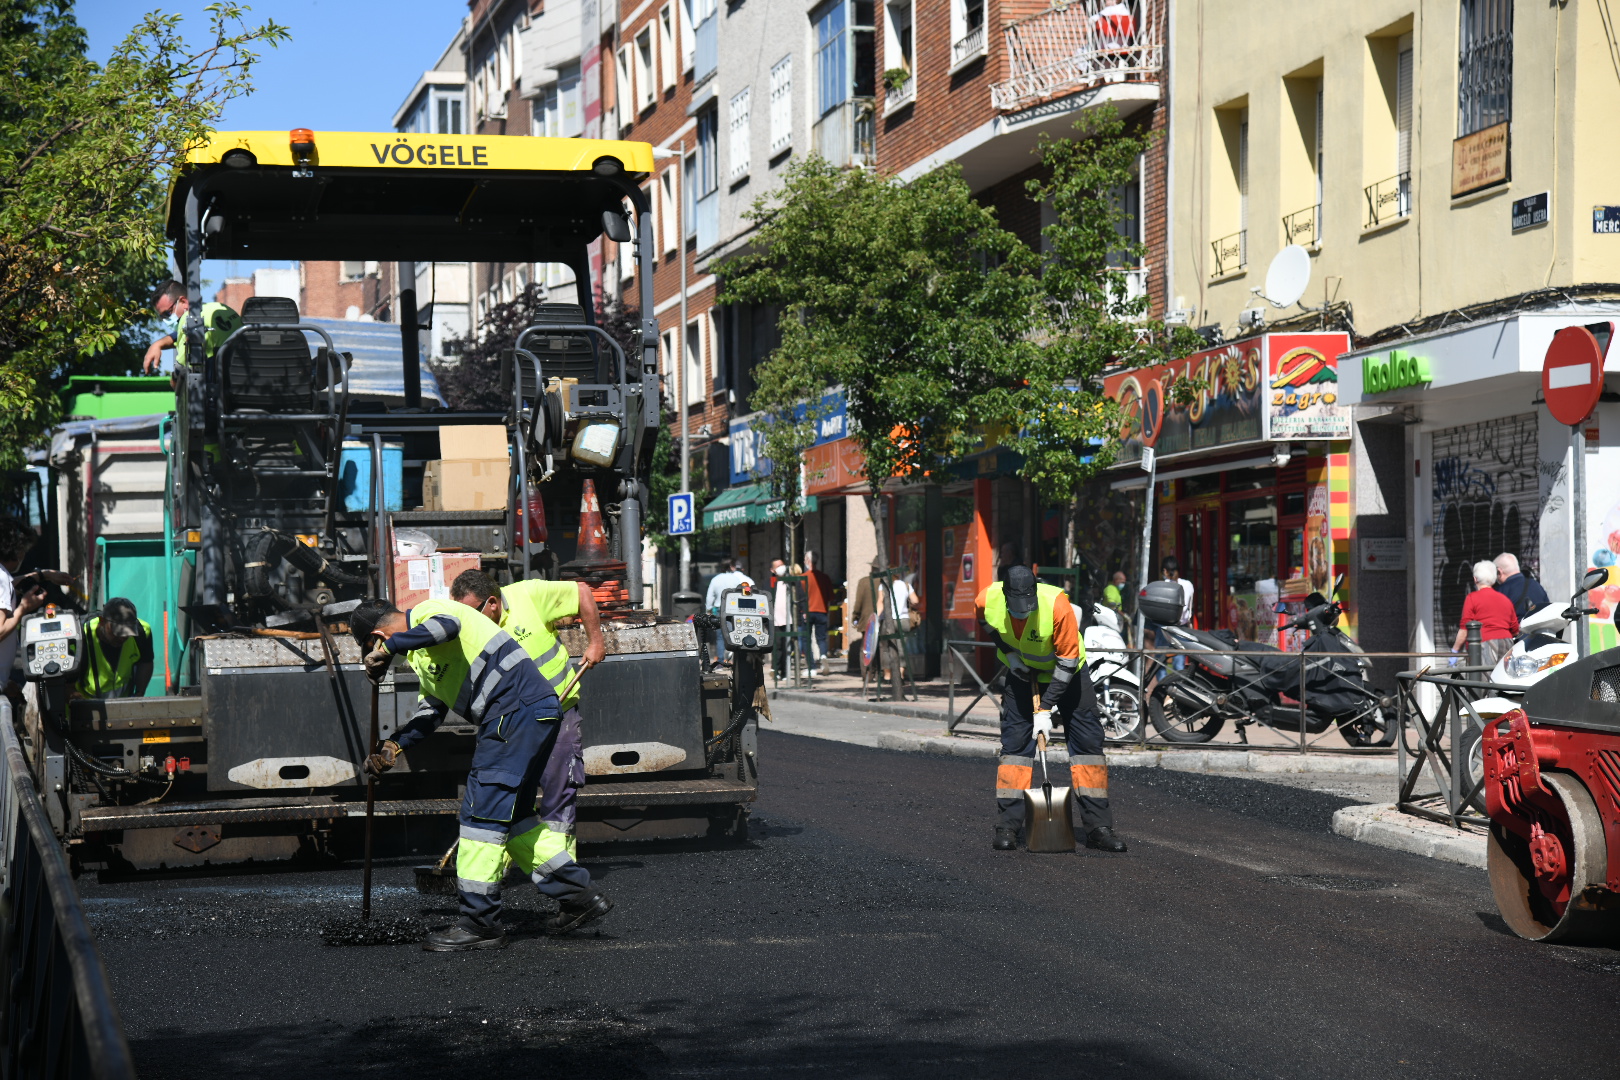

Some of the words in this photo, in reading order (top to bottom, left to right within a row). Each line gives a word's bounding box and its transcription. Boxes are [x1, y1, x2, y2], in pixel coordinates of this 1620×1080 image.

[370, 138, 489, 166] VÖGELE
[1512, 212, 1531, 229] MARCELO
[1532, 207, 1547, 223] USERA
[672, 498, 689, 533] P
[713, 505, 747, 523] DEPORTE
